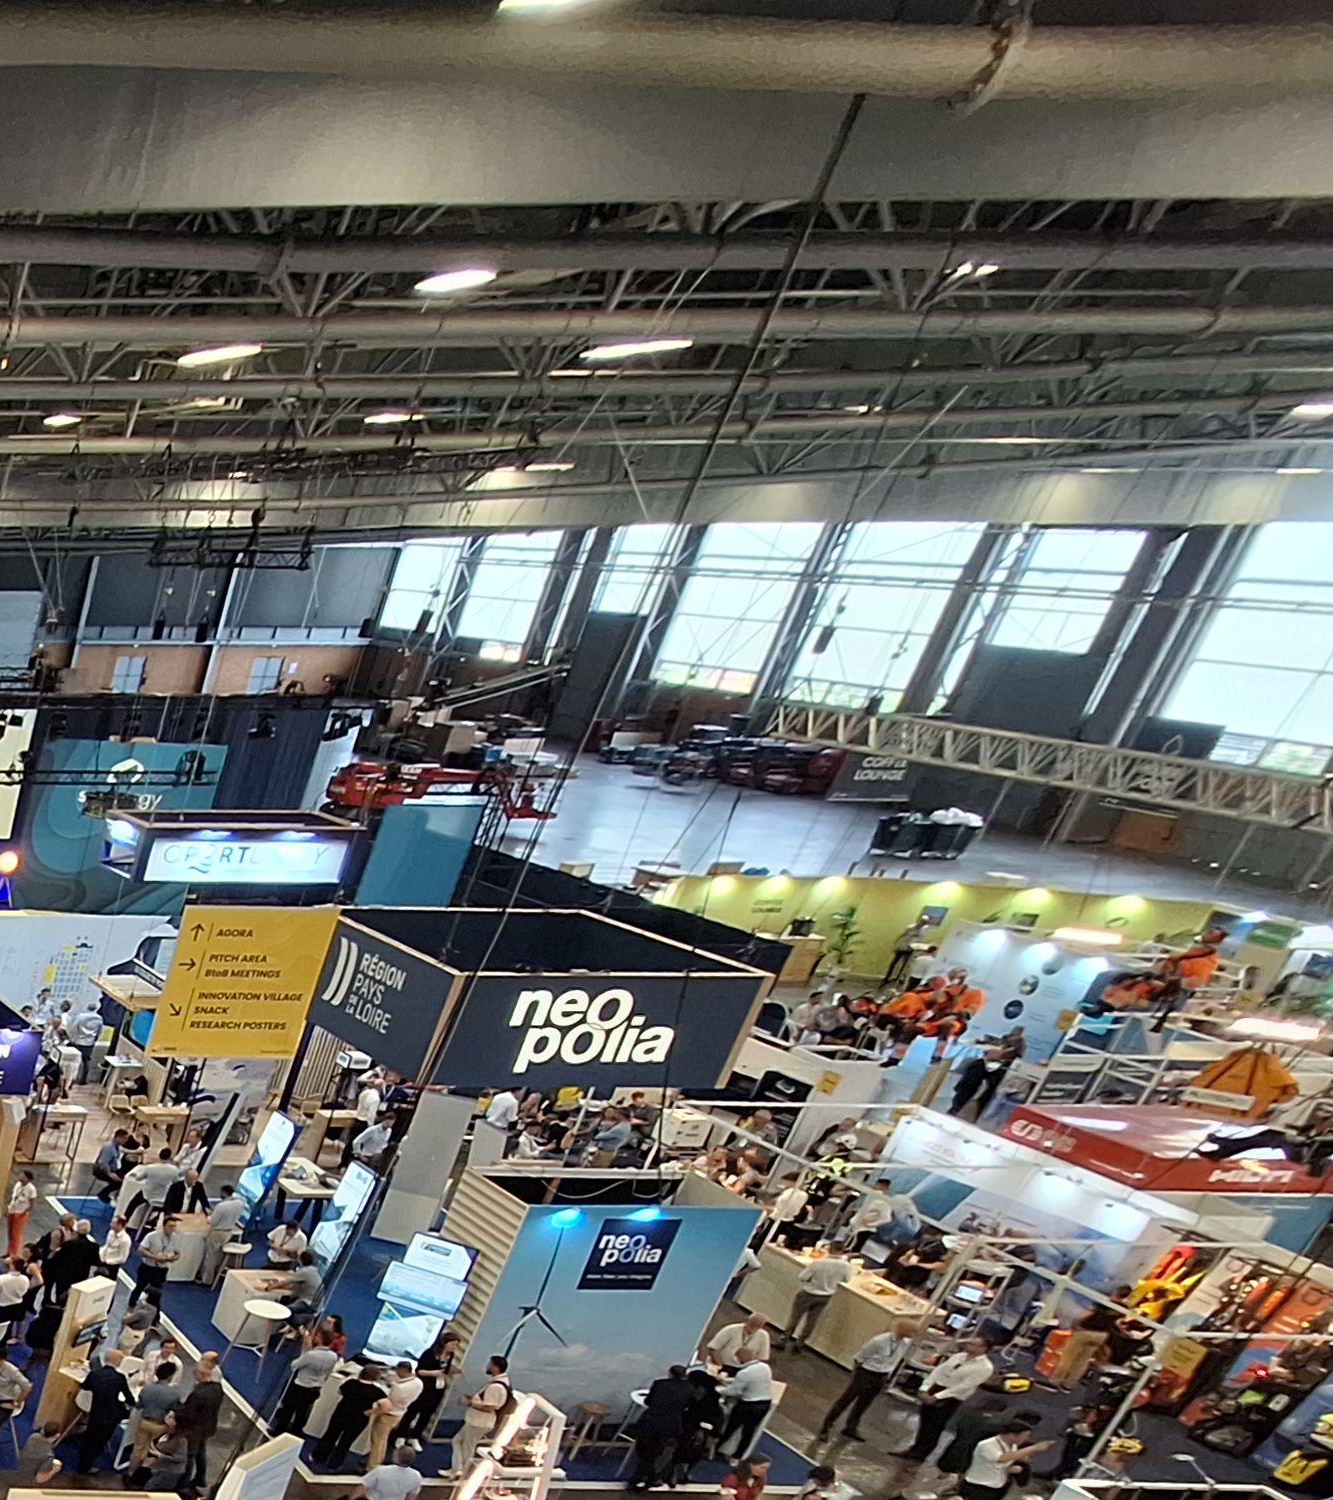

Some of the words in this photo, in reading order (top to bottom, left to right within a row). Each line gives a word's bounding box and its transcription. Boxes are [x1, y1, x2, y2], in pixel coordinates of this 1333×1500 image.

[216, 928, 254, 938] AGORA
[209, 954, 239, 963] PITCH
[240, 954, 268, 963] AREA
[205, 969, 229, 978] BtoB
[229, 969, 282, 979] MEETINGS
[359, 952, 407, 991] RÉGION
[198, 992, 261, 1001] INNOVATION
[262, 992, 304, 1002] VILLAGE
[353, 974, 385, 1005] PAYS
[194, 1005, 230, 1015] SNACK
[508, 989, 634, 1030] neo
[190, 1020, 242, 1030] RESEARCH
[242, 1021, 287, 1030] POSTERS
[355, 1004, 392, 1034] LOIRE
[512, 1015, 675, 1074] polia
[598, 1234, 646, 1250] neo
[599, 1244, 663, 1267] polia
